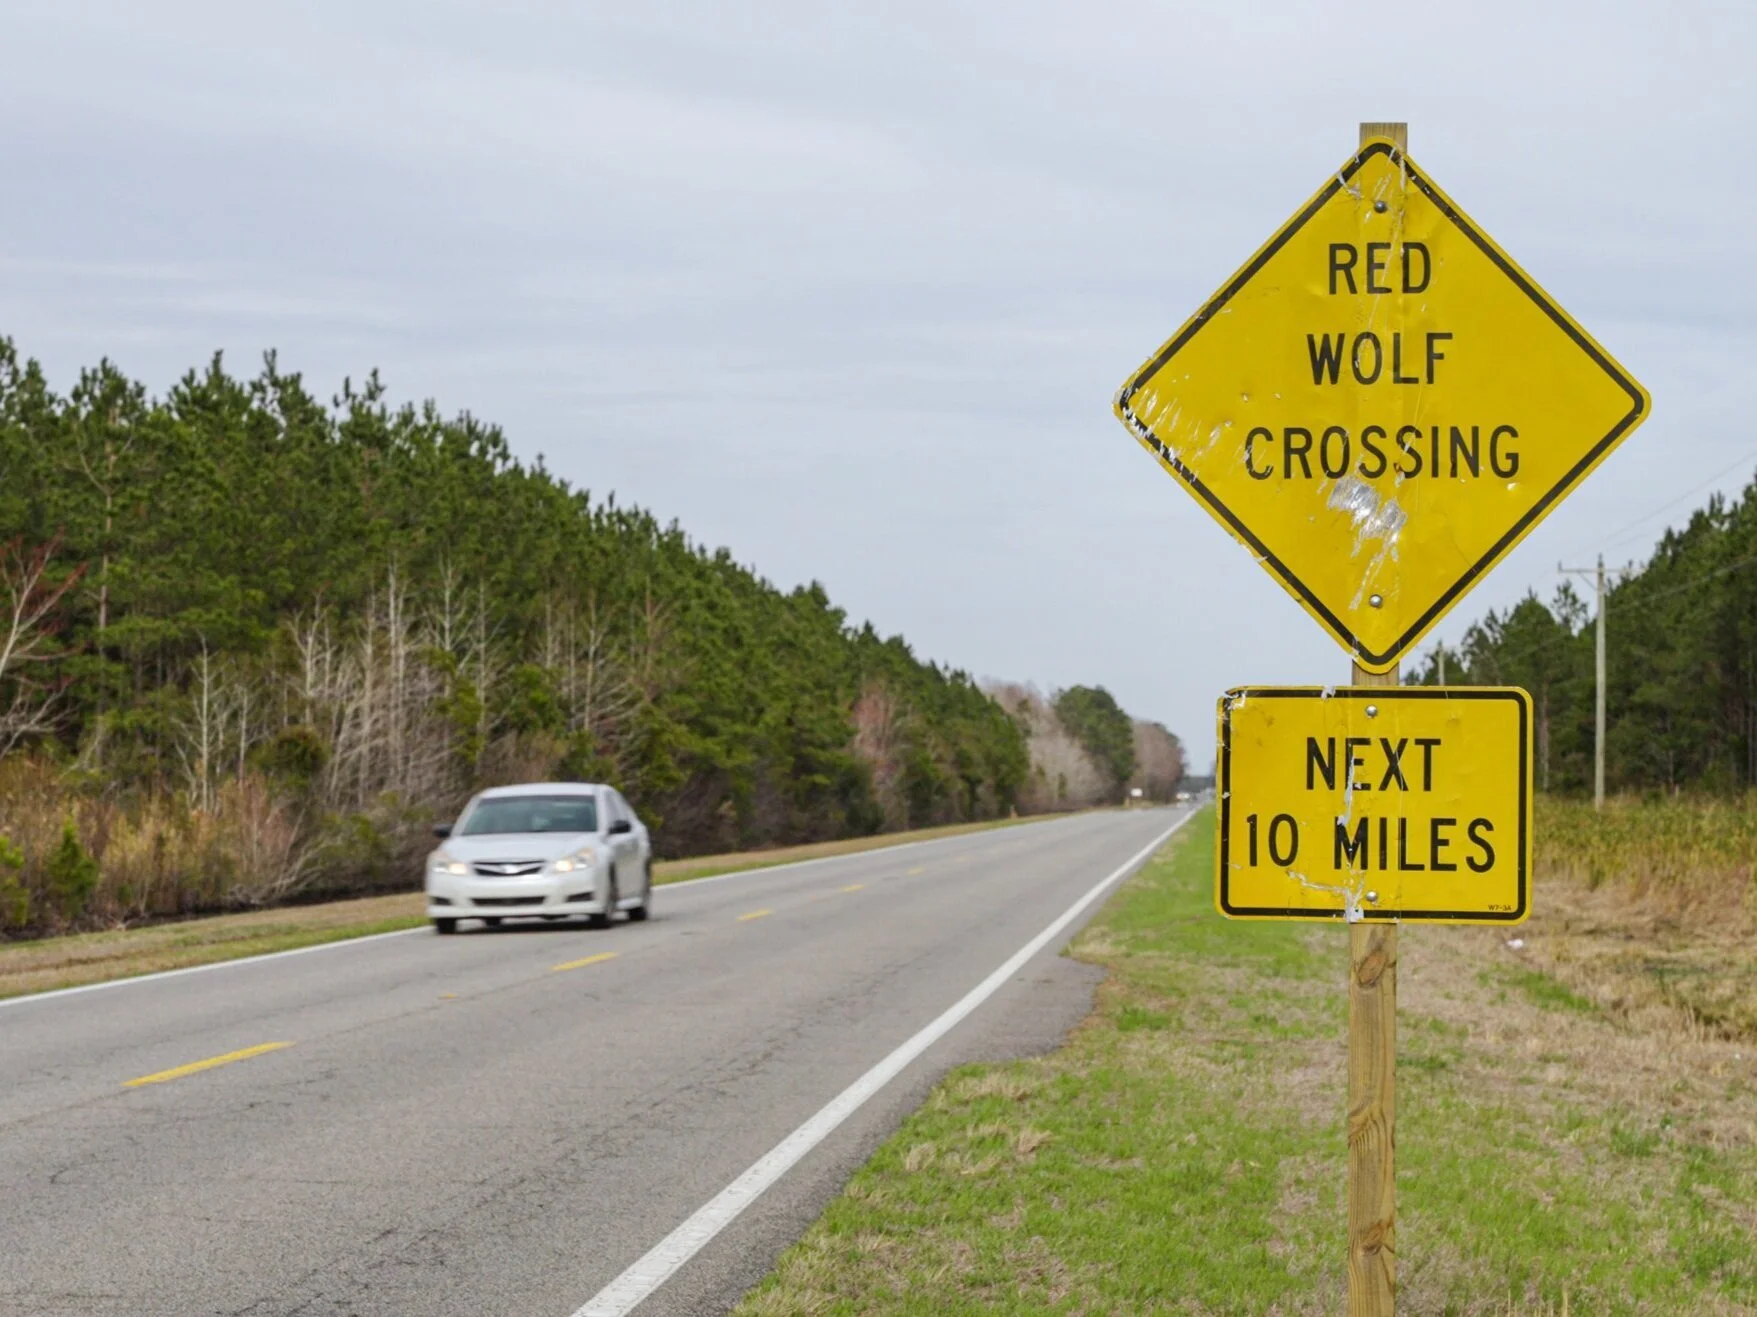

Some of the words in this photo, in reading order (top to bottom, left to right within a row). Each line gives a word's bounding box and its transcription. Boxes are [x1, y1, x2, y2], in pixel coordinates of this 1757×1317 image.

[1329, 242, 1432, 295] RED
[1306, 332, 1454, 385] WOLF
[1244, 424, 1520, 480] CROSSING
[1306, 737, 1441, 791] NEXT
[1246, 813, 1299, 867] 10
[1334, 816, 1496, 873] MILES
